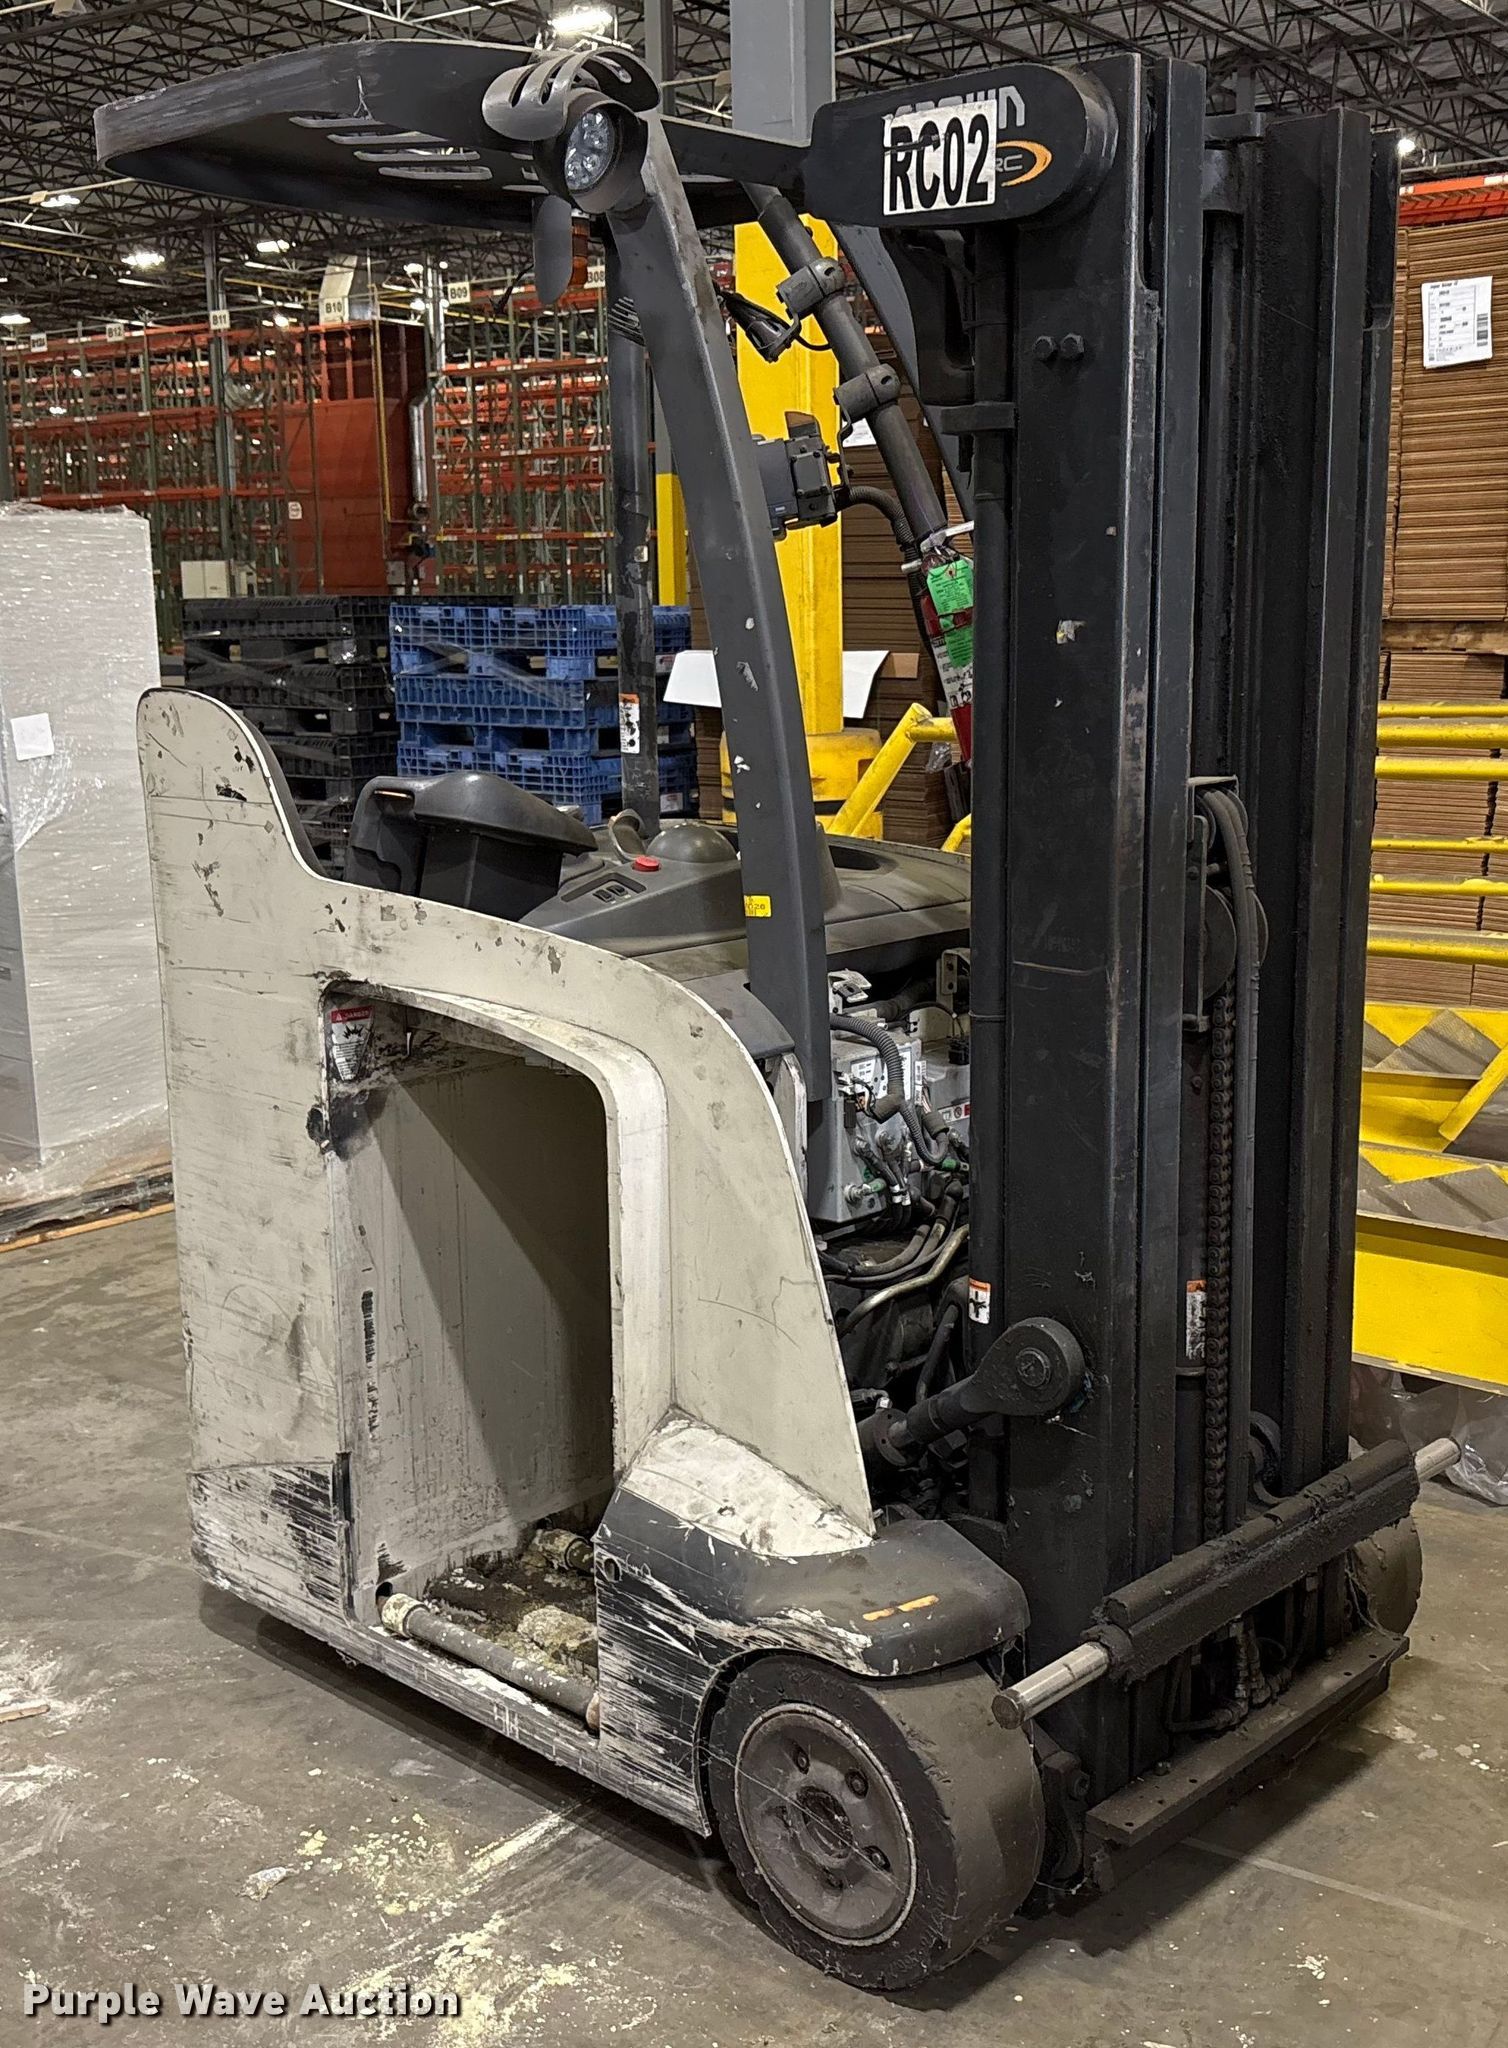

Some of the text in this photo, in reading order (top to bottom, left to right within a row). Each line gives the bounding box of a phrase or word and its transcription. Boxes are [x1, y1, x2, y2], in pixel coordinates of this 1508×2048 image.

[889, 113, 990, 212] RC02
[450, 286, 468, 299] B09
[325, 301, 342, 314] B10
[212, 314, 227, 326] B11
[107, 326, 123, 338] B12
